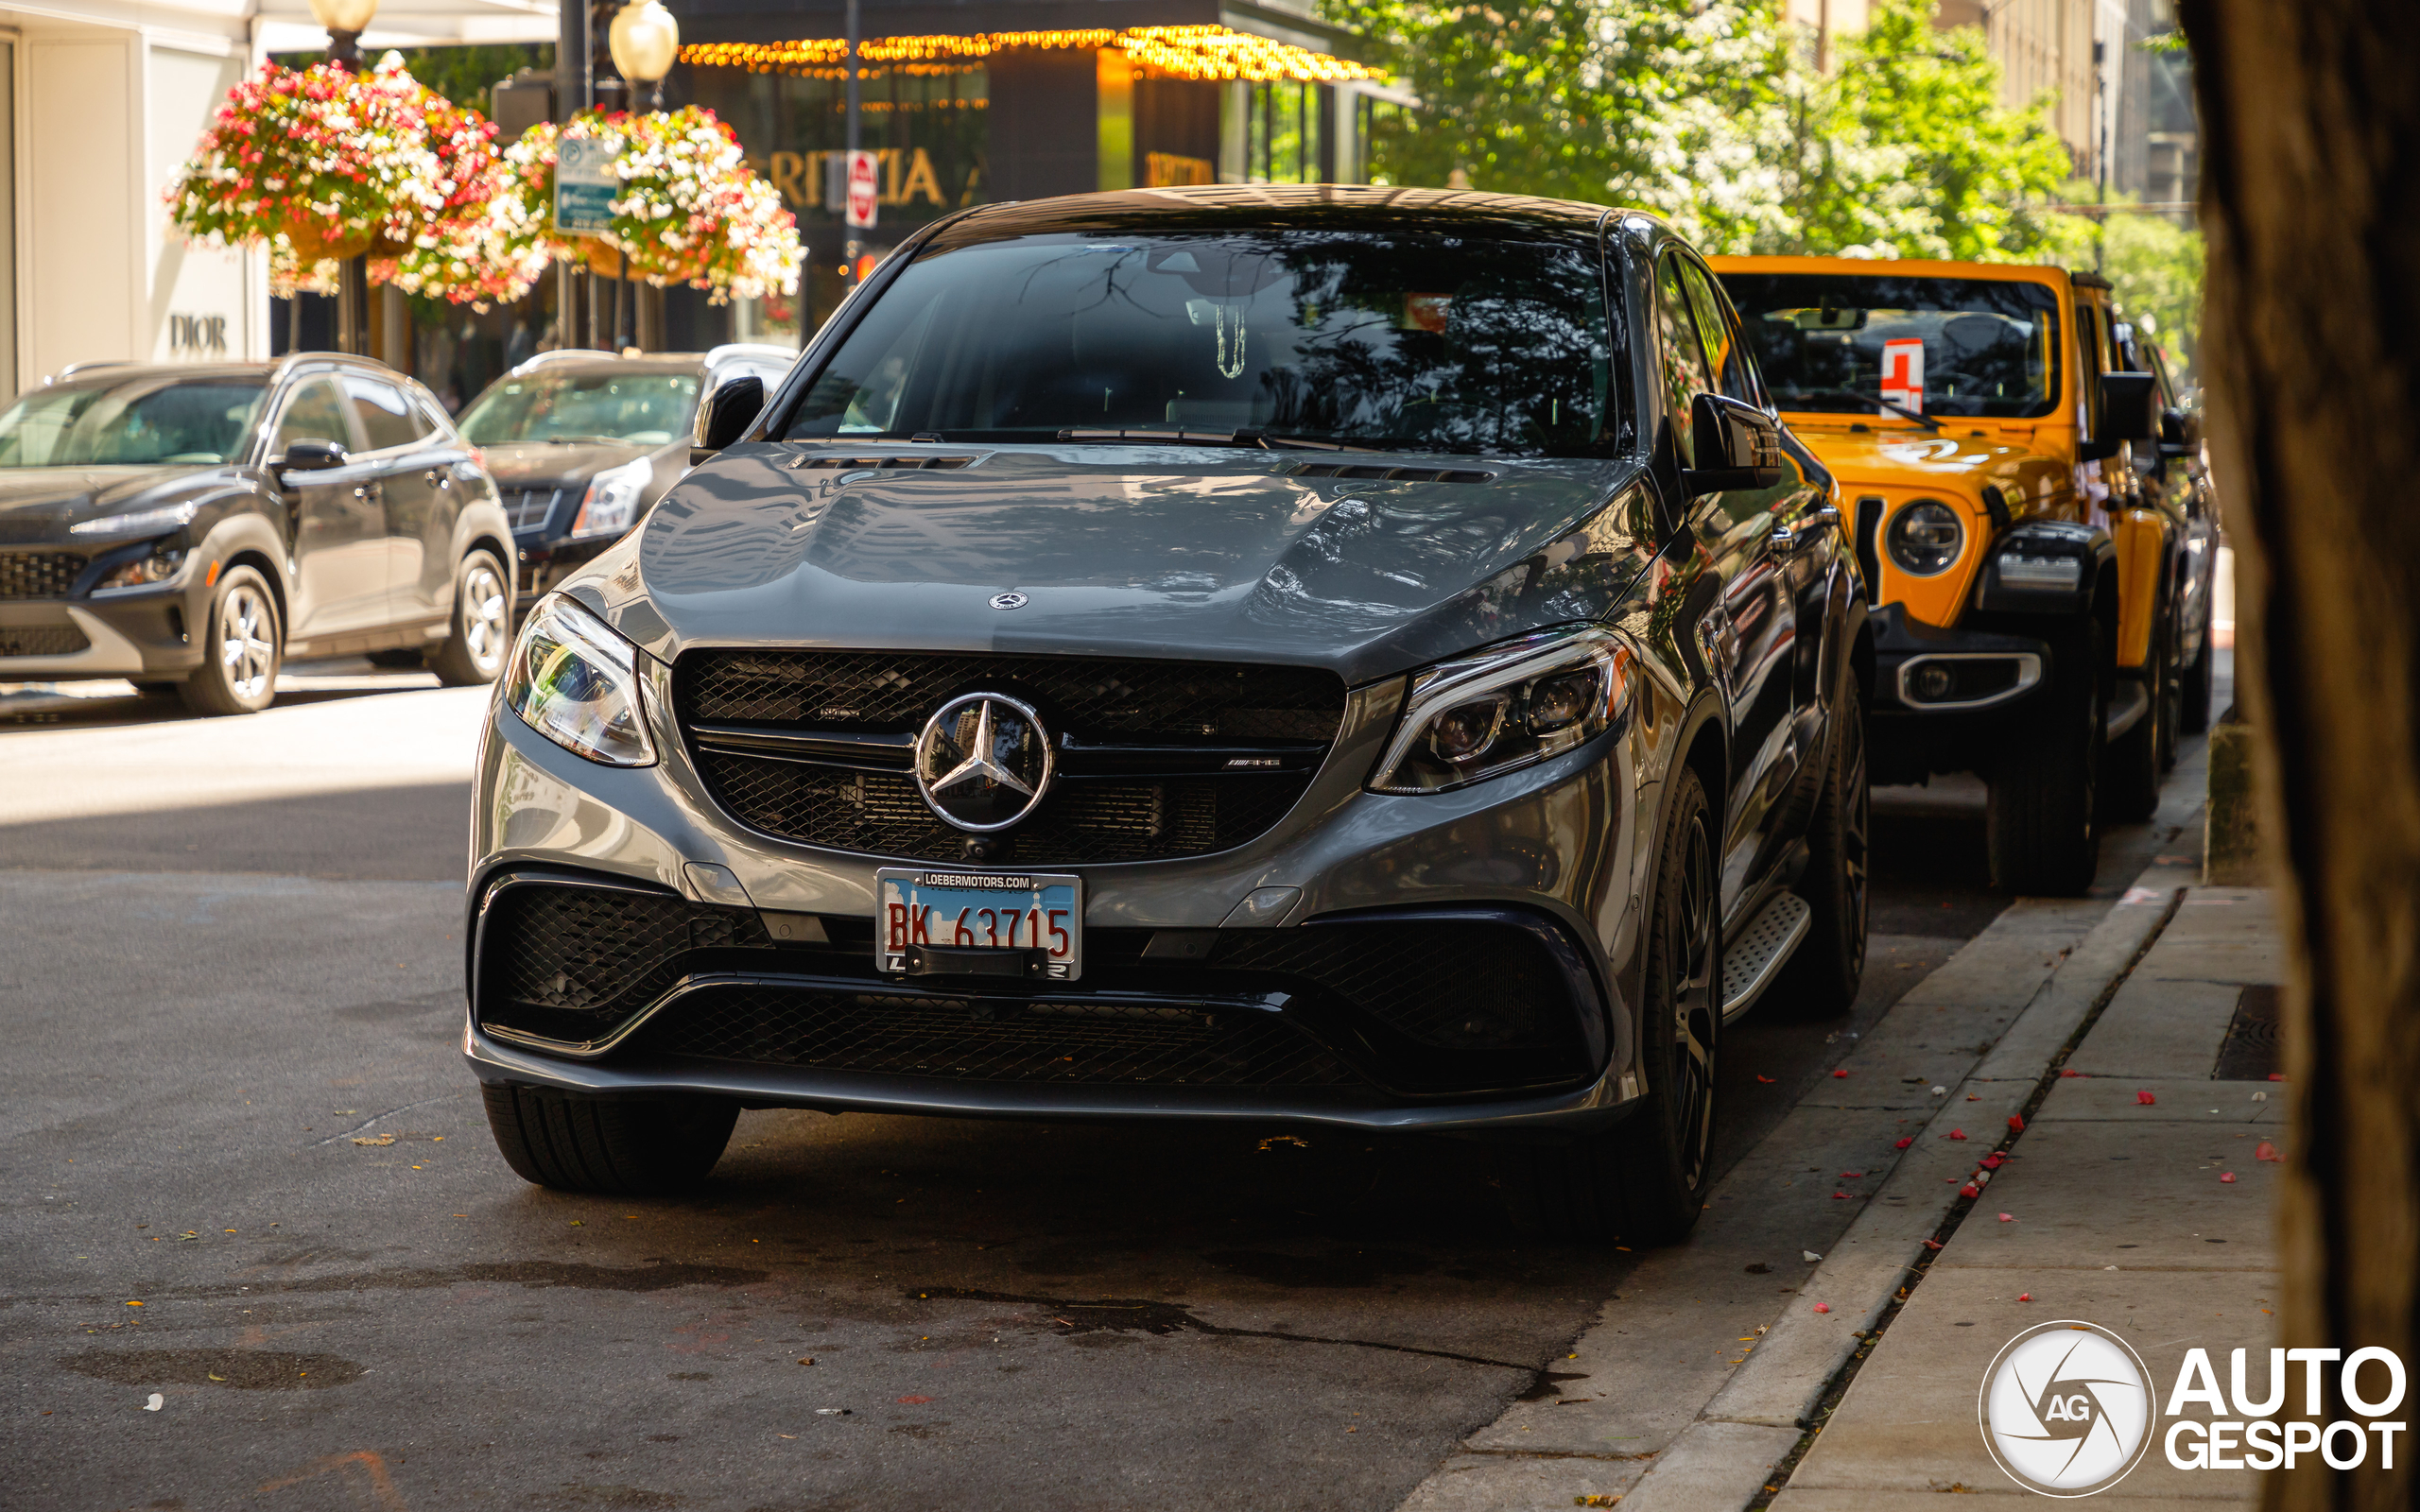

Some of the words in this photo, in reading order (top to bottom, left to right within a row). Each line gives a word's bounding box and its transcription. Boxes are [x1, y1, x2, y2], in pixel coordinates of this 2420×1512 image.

[171, 315, 227, 351] DIOR
[925, 873, 1030, 889] LOEBERMOTORS.COM
[888, 902, 931, 952] BK
[954, 905, 1069, 958] 63715
